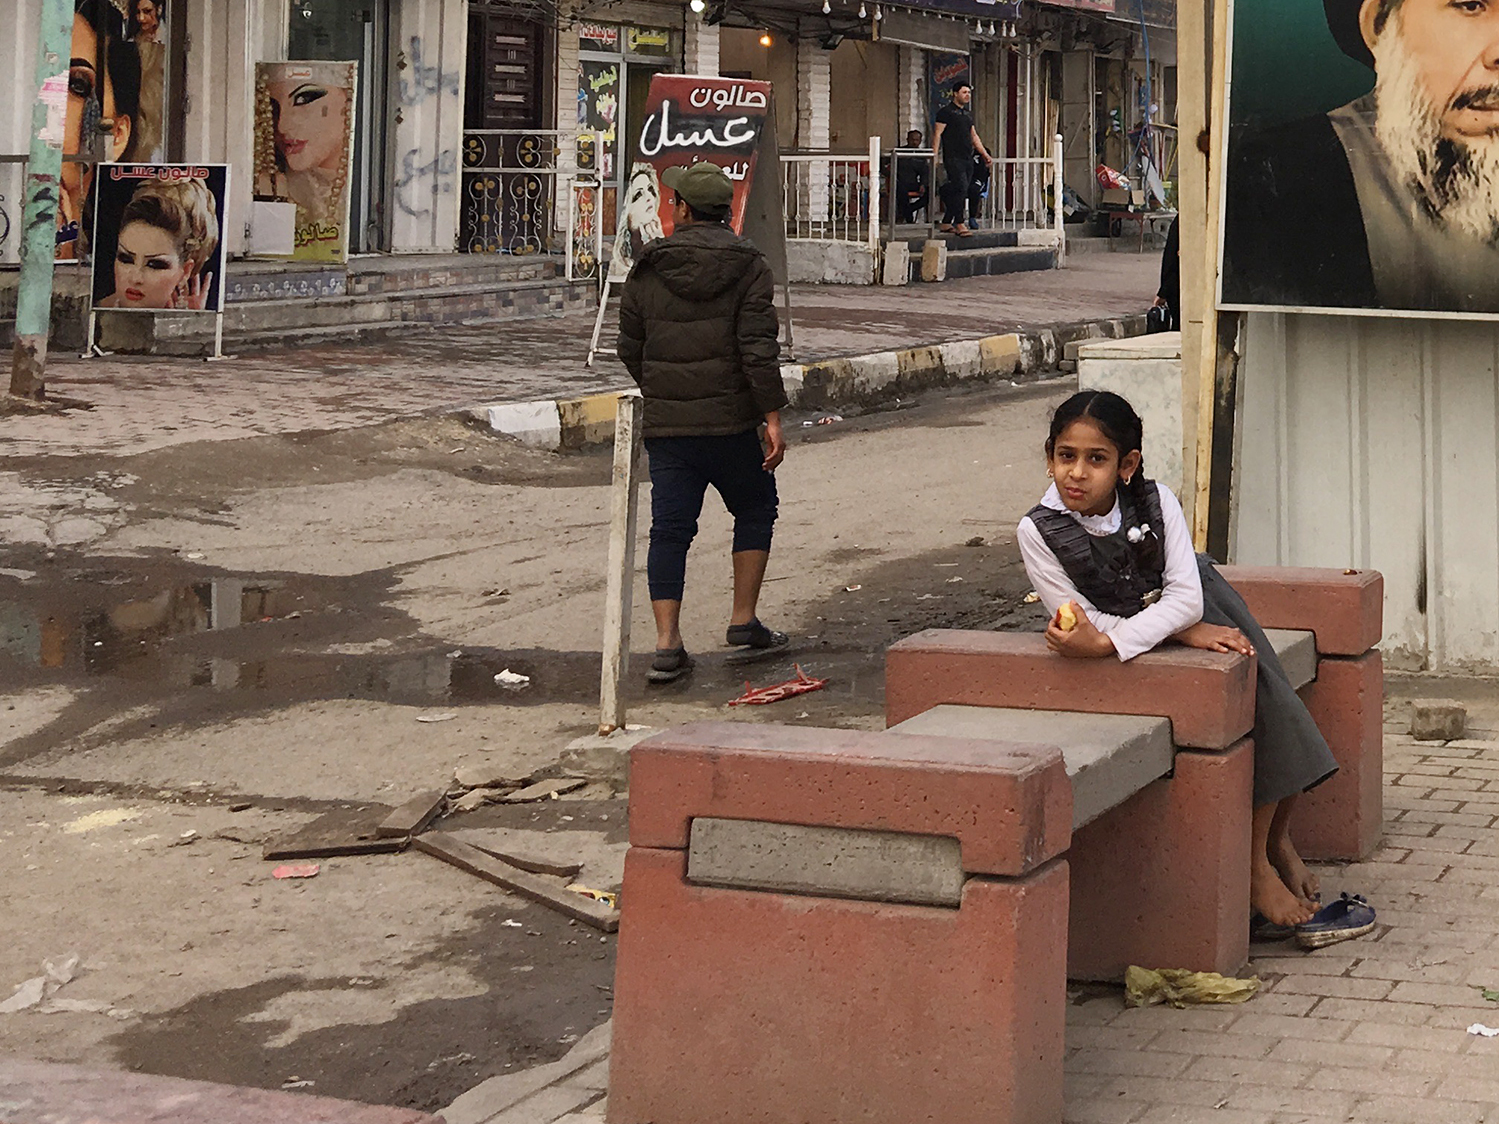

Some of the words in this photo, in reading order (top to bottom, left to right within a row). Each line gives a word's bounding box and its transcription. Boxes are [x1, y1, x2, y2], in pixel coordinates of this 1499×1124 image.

[690, 85, 767, 111] صالون
[640, 99, 755, 156] عسل
[110, 166, 157, 181] عسل
[158, 166, 209, 181] صالون
